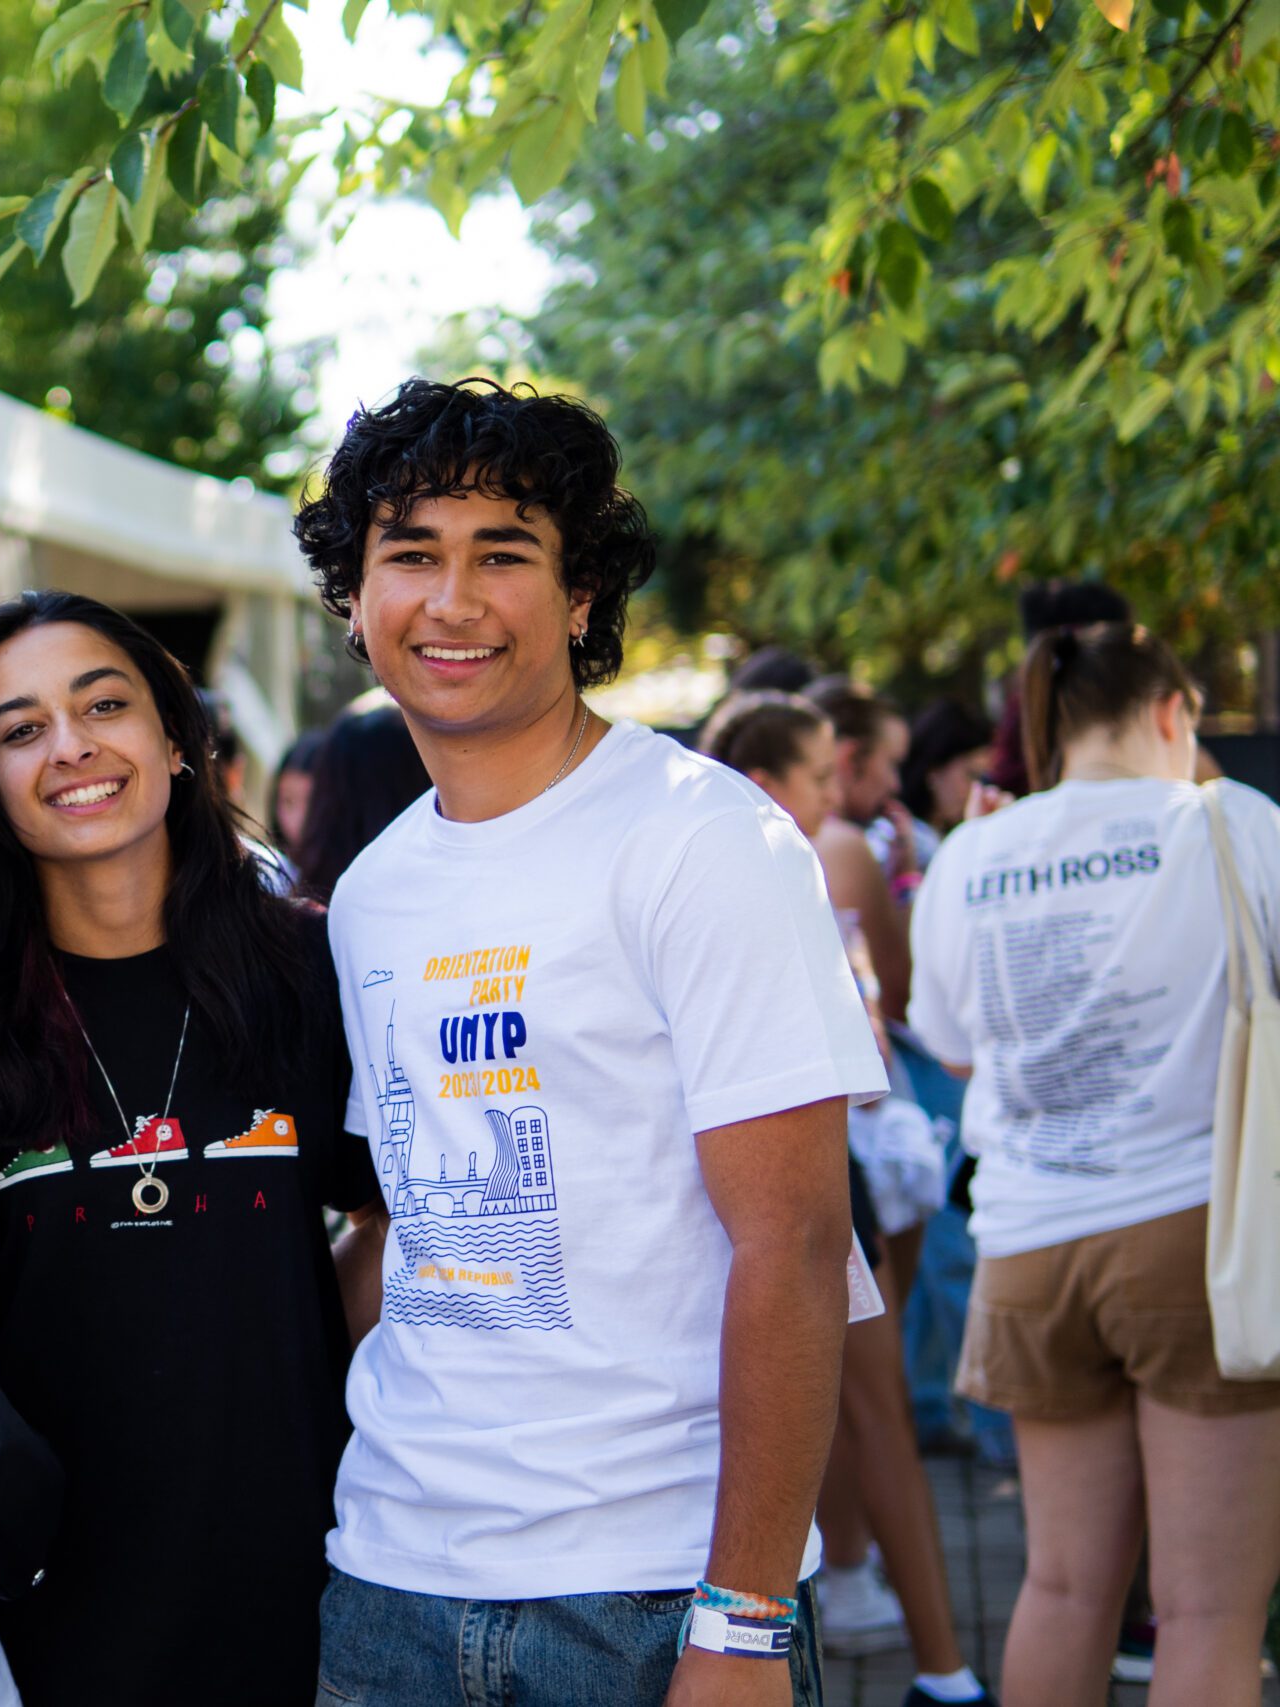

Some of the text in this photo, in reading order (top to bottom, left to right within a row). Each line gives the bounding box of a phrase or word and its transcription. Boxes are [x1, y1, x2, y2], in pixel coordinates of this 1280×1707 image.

[966, 845, 1160, 904] LEITH ROSS
[423, 945, 531, 981] ORIENTATION
[470, 975, 526, 1007] PARTY
[440, 1011, 527, 1064] UNYP
[438, 1066, 540, 1099] 2023/2024
